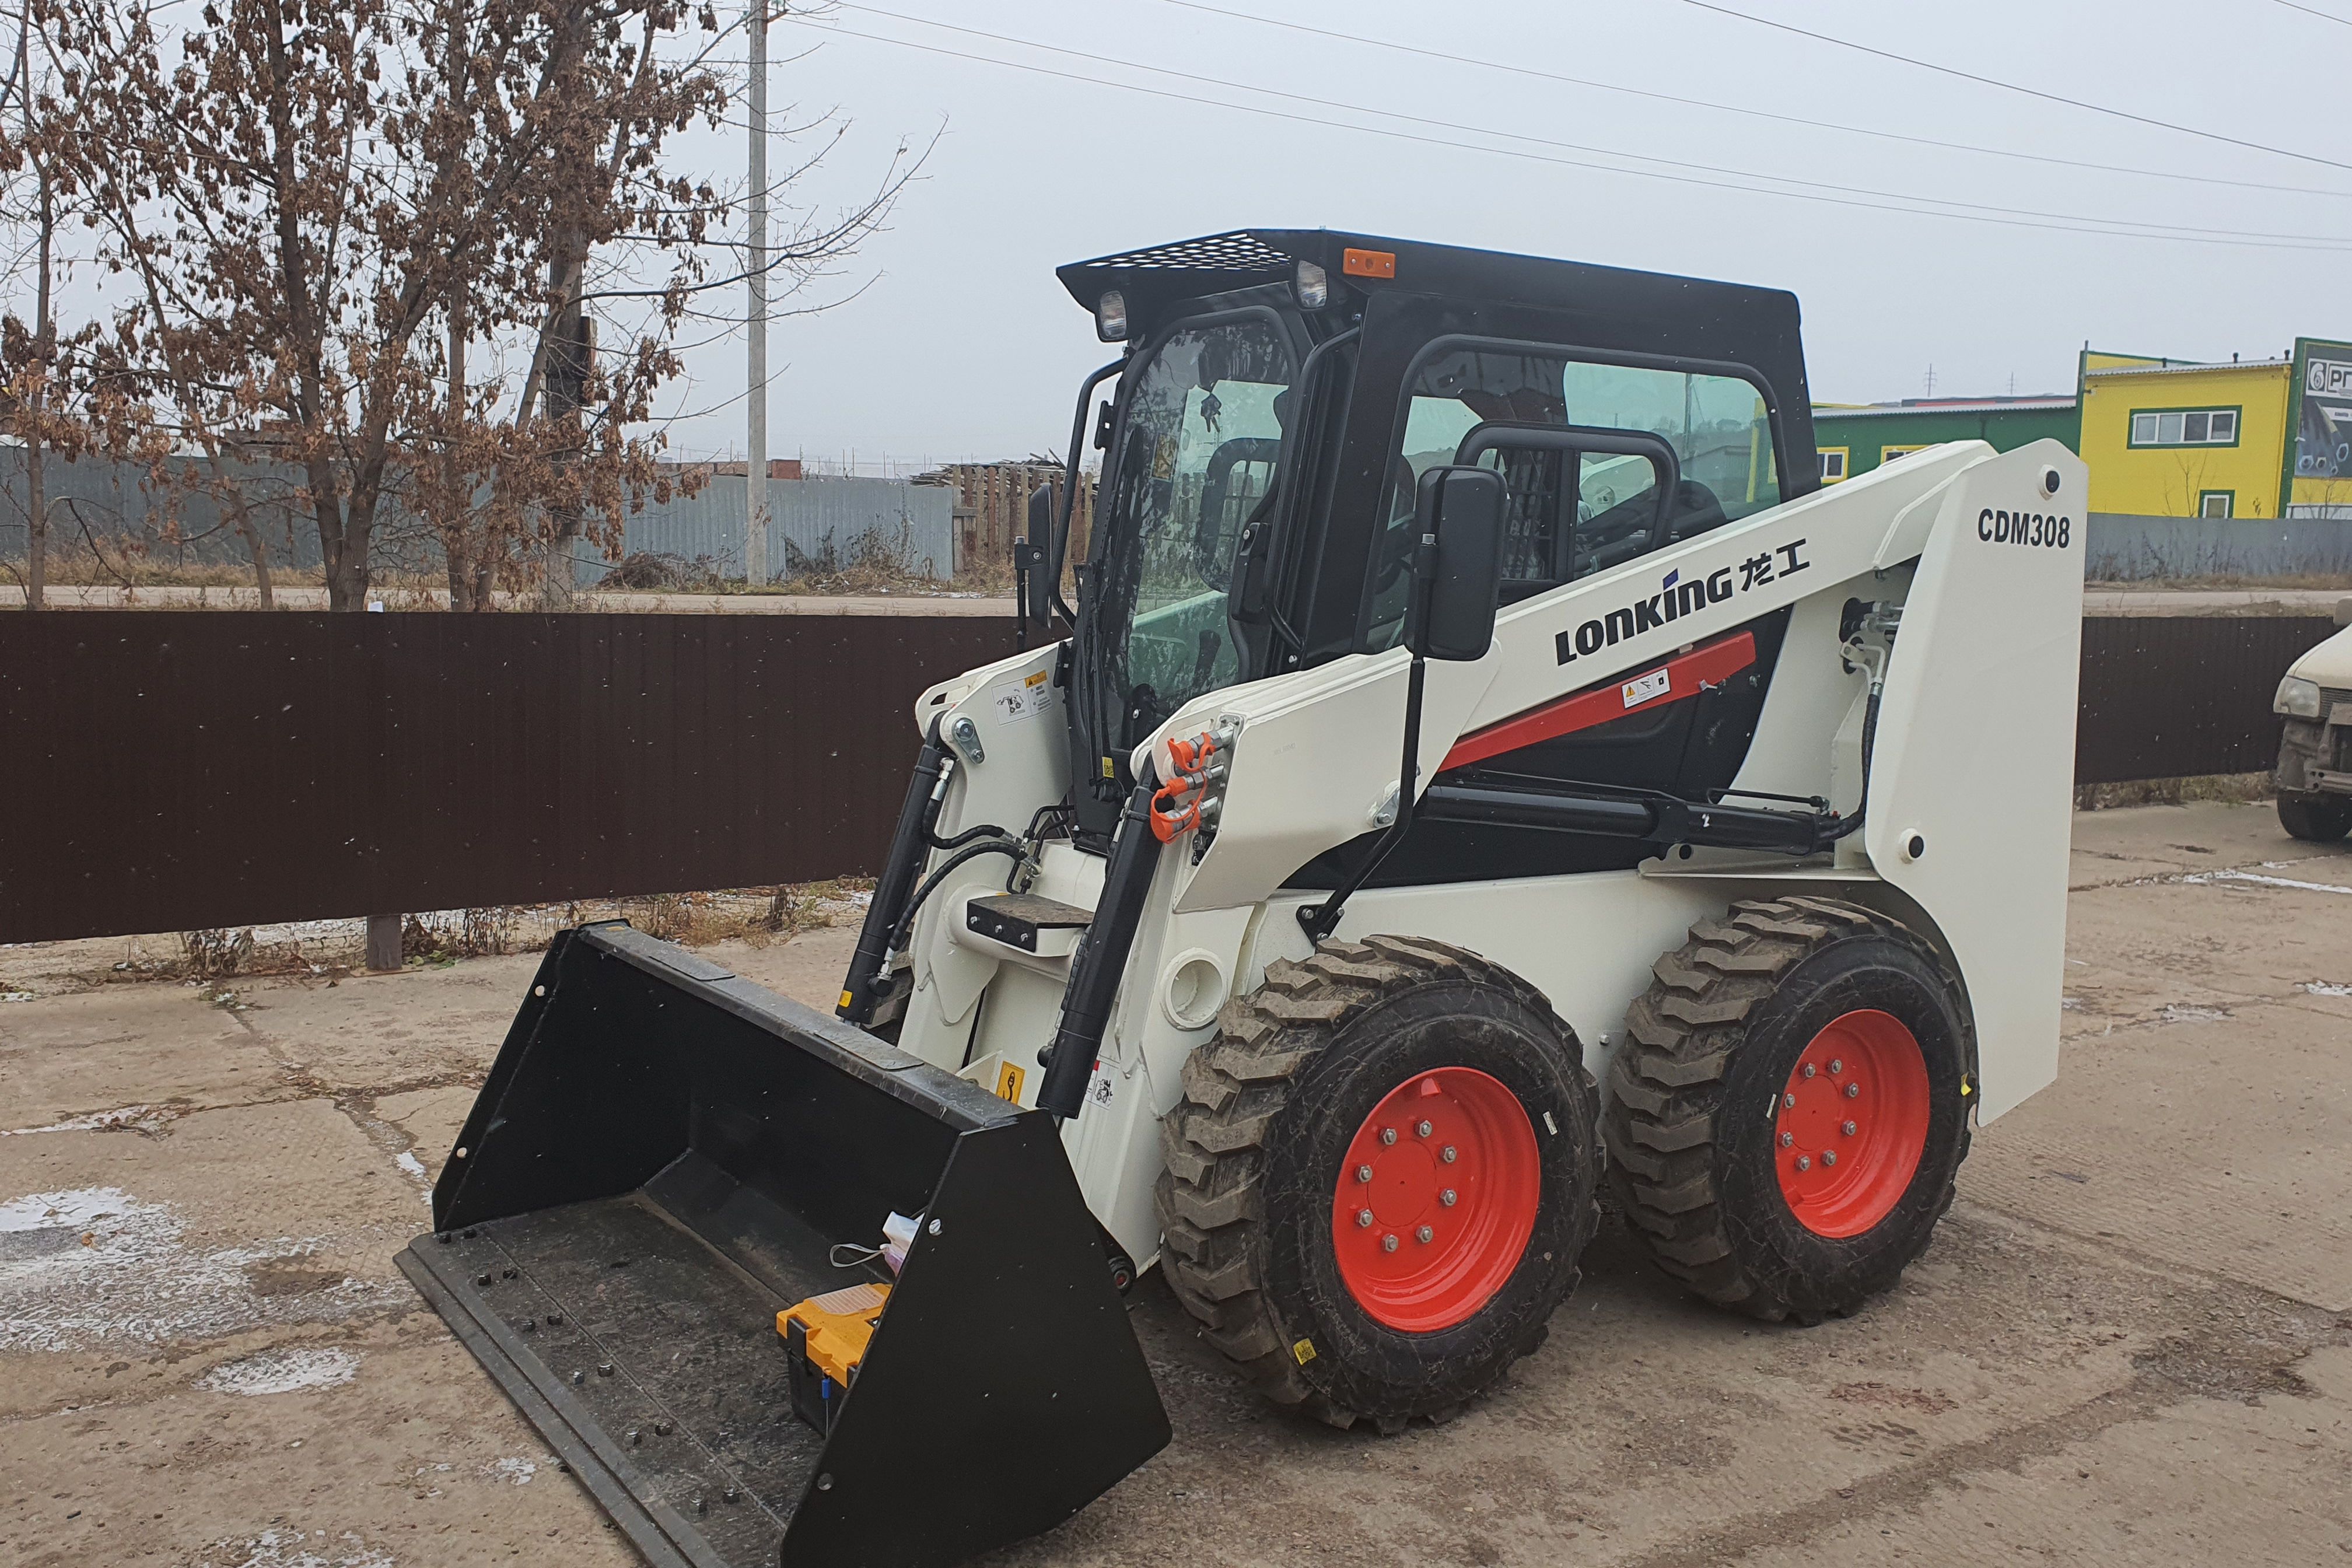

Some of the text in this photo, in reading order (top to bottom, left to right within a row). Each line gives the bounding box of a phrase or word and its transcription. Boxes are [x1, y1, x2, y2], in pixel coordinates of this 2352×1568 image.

[1978, 508, 2070, 548] CDM308
[1555, 538, 1810, 666] LONKING 龙工
